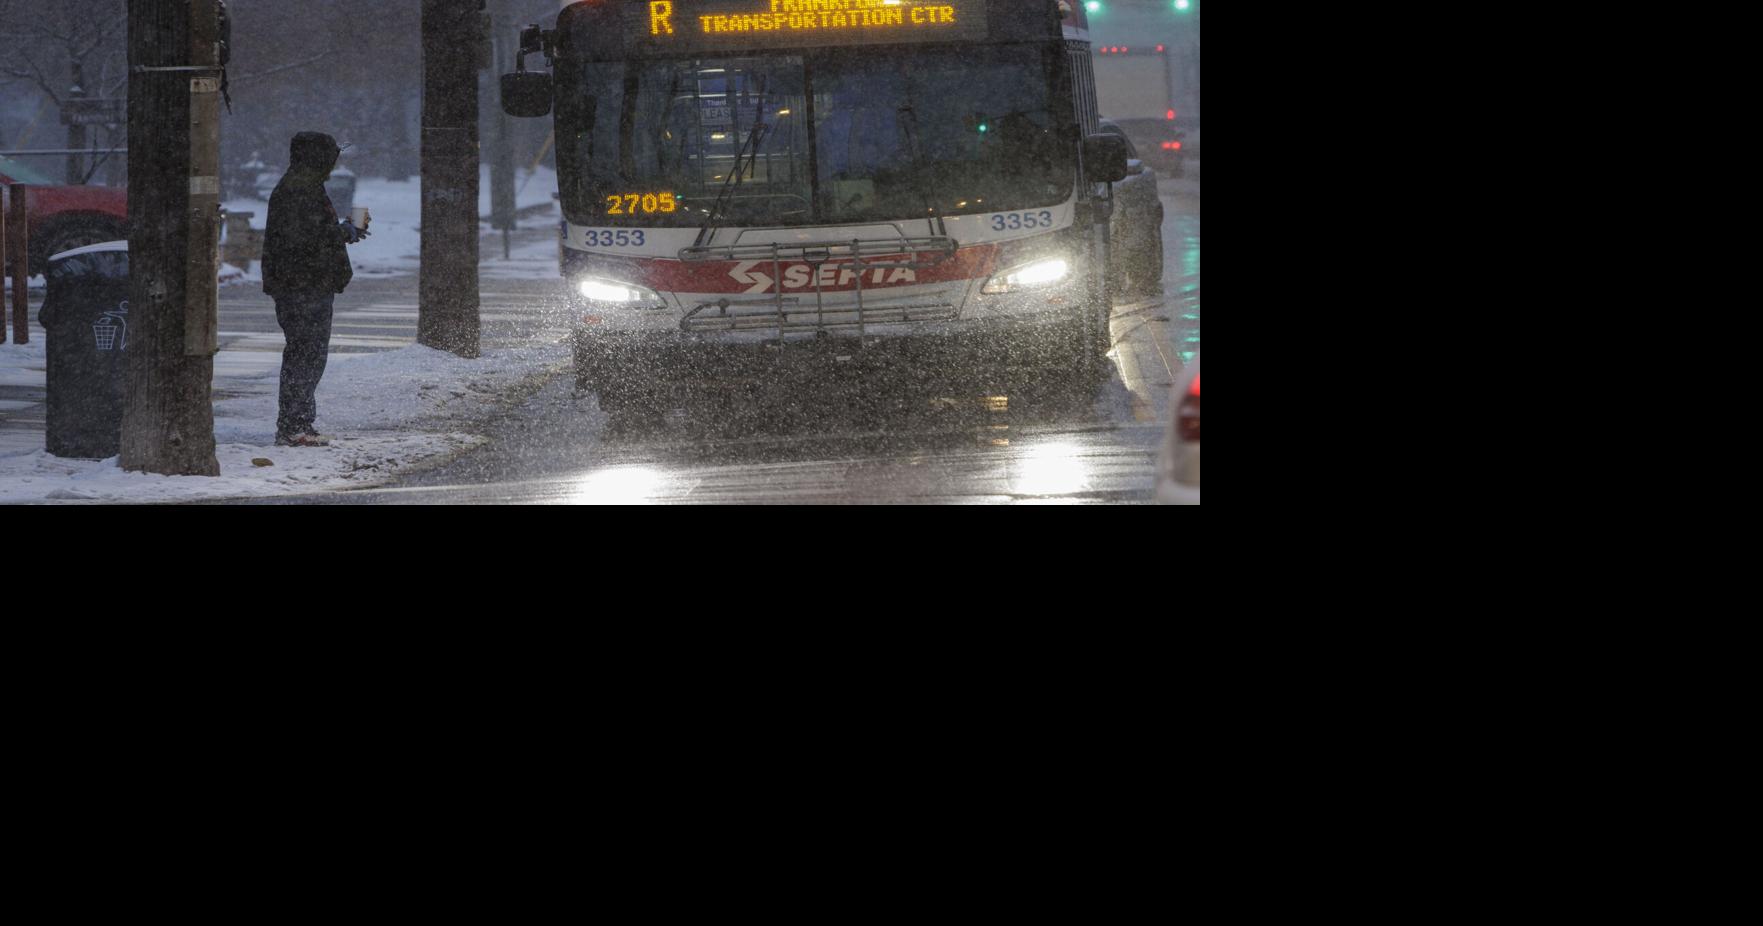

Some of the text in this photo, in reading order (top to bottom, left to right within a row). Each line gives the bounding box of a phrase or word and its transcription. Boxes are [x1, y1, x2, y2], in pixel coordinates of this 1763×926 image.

[650, 1, 672, 34] R
[699, 6, 954, 33] TRANSPORTATION CTR
[607, 192, 676, 215] 2705
[990, 210, 1052, 231] 3353
[585, 229, 645, 247] 3353
